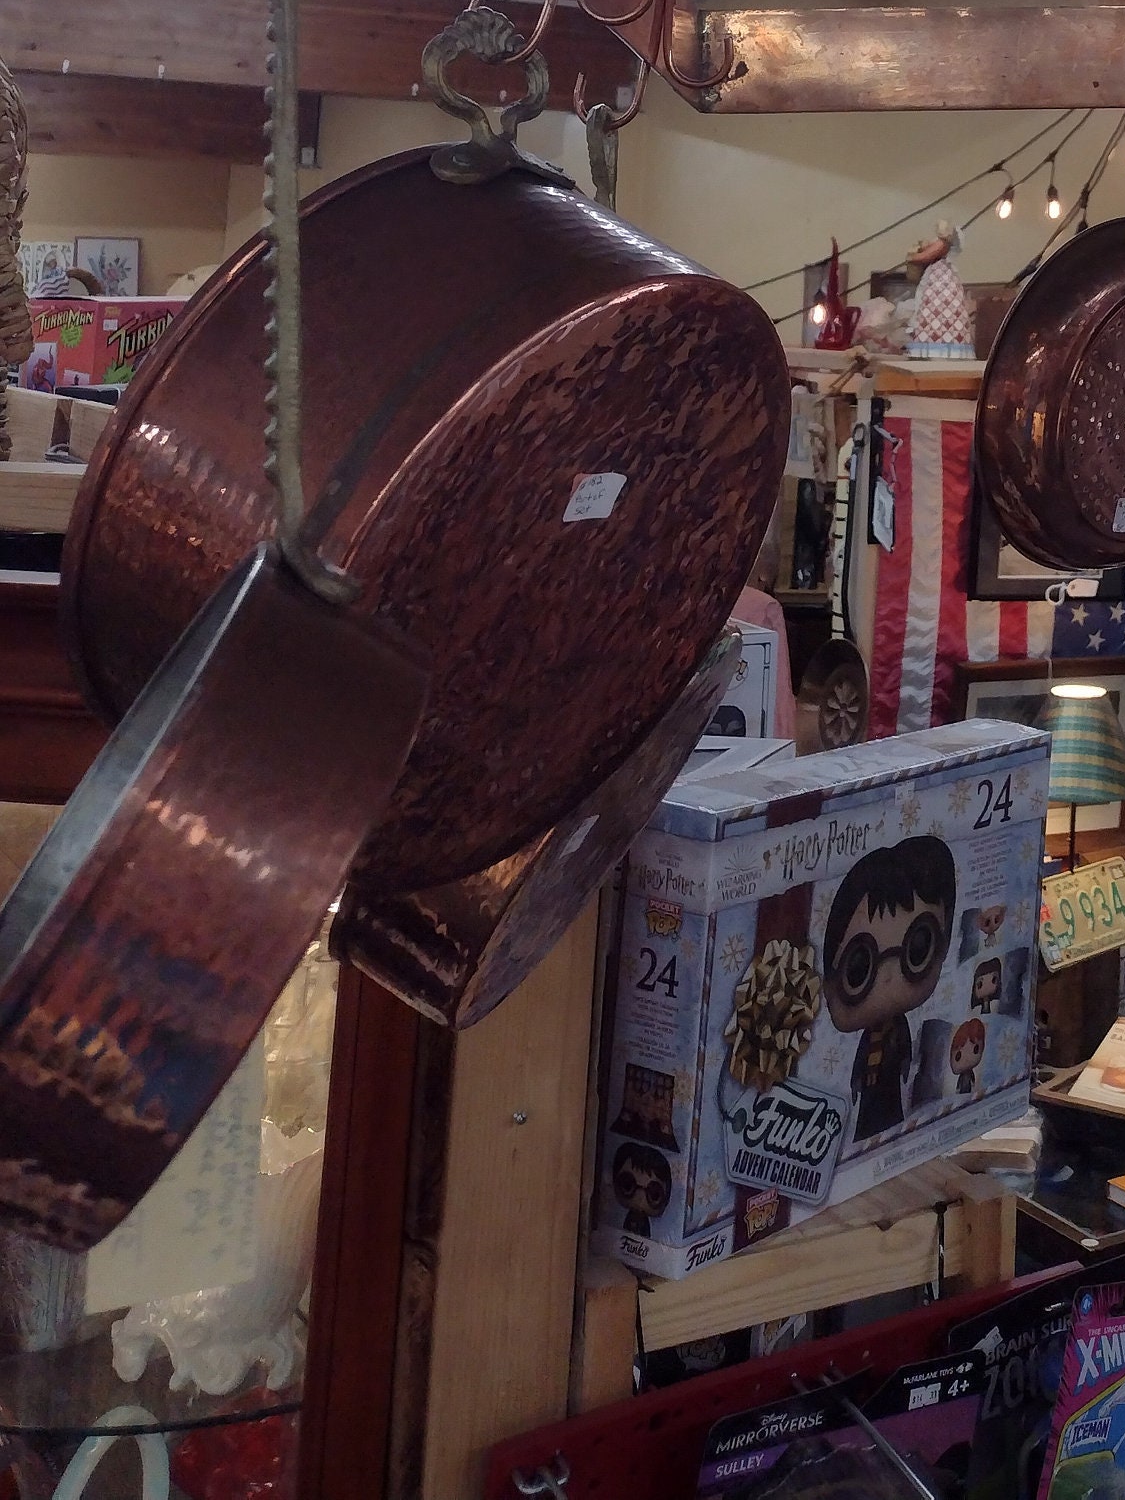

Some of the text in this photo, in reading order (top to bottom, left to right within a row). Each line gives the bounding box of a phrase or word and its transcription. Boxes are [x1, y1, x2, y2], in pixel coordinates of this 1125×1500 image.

[973, 774, 1013, 830] 24
[780, 820, 871, 881] Harry Potter
[638, 864, 696, 896] Harry Potter
[721, 882, 757, 901] WORLD
[636, 947, 679, 998] 24
[744, 1084, 841, 1165] Funko
[732, 1149, 822, 1195] ADVENT CALENDAR
[620, 1236, 649, 1258] Funko
[685, 1234, 728, 1272] Funko
[985, 1328, 1036, 1366] BRAIN
[947, 1379, 970, 1397] 4+
[715, 1408, 825, 1455] MIRRORVERSE
[1071, 1419, 1111, 1446] ICEMAN
[715, 1453, 765, 1478] SULLEY
